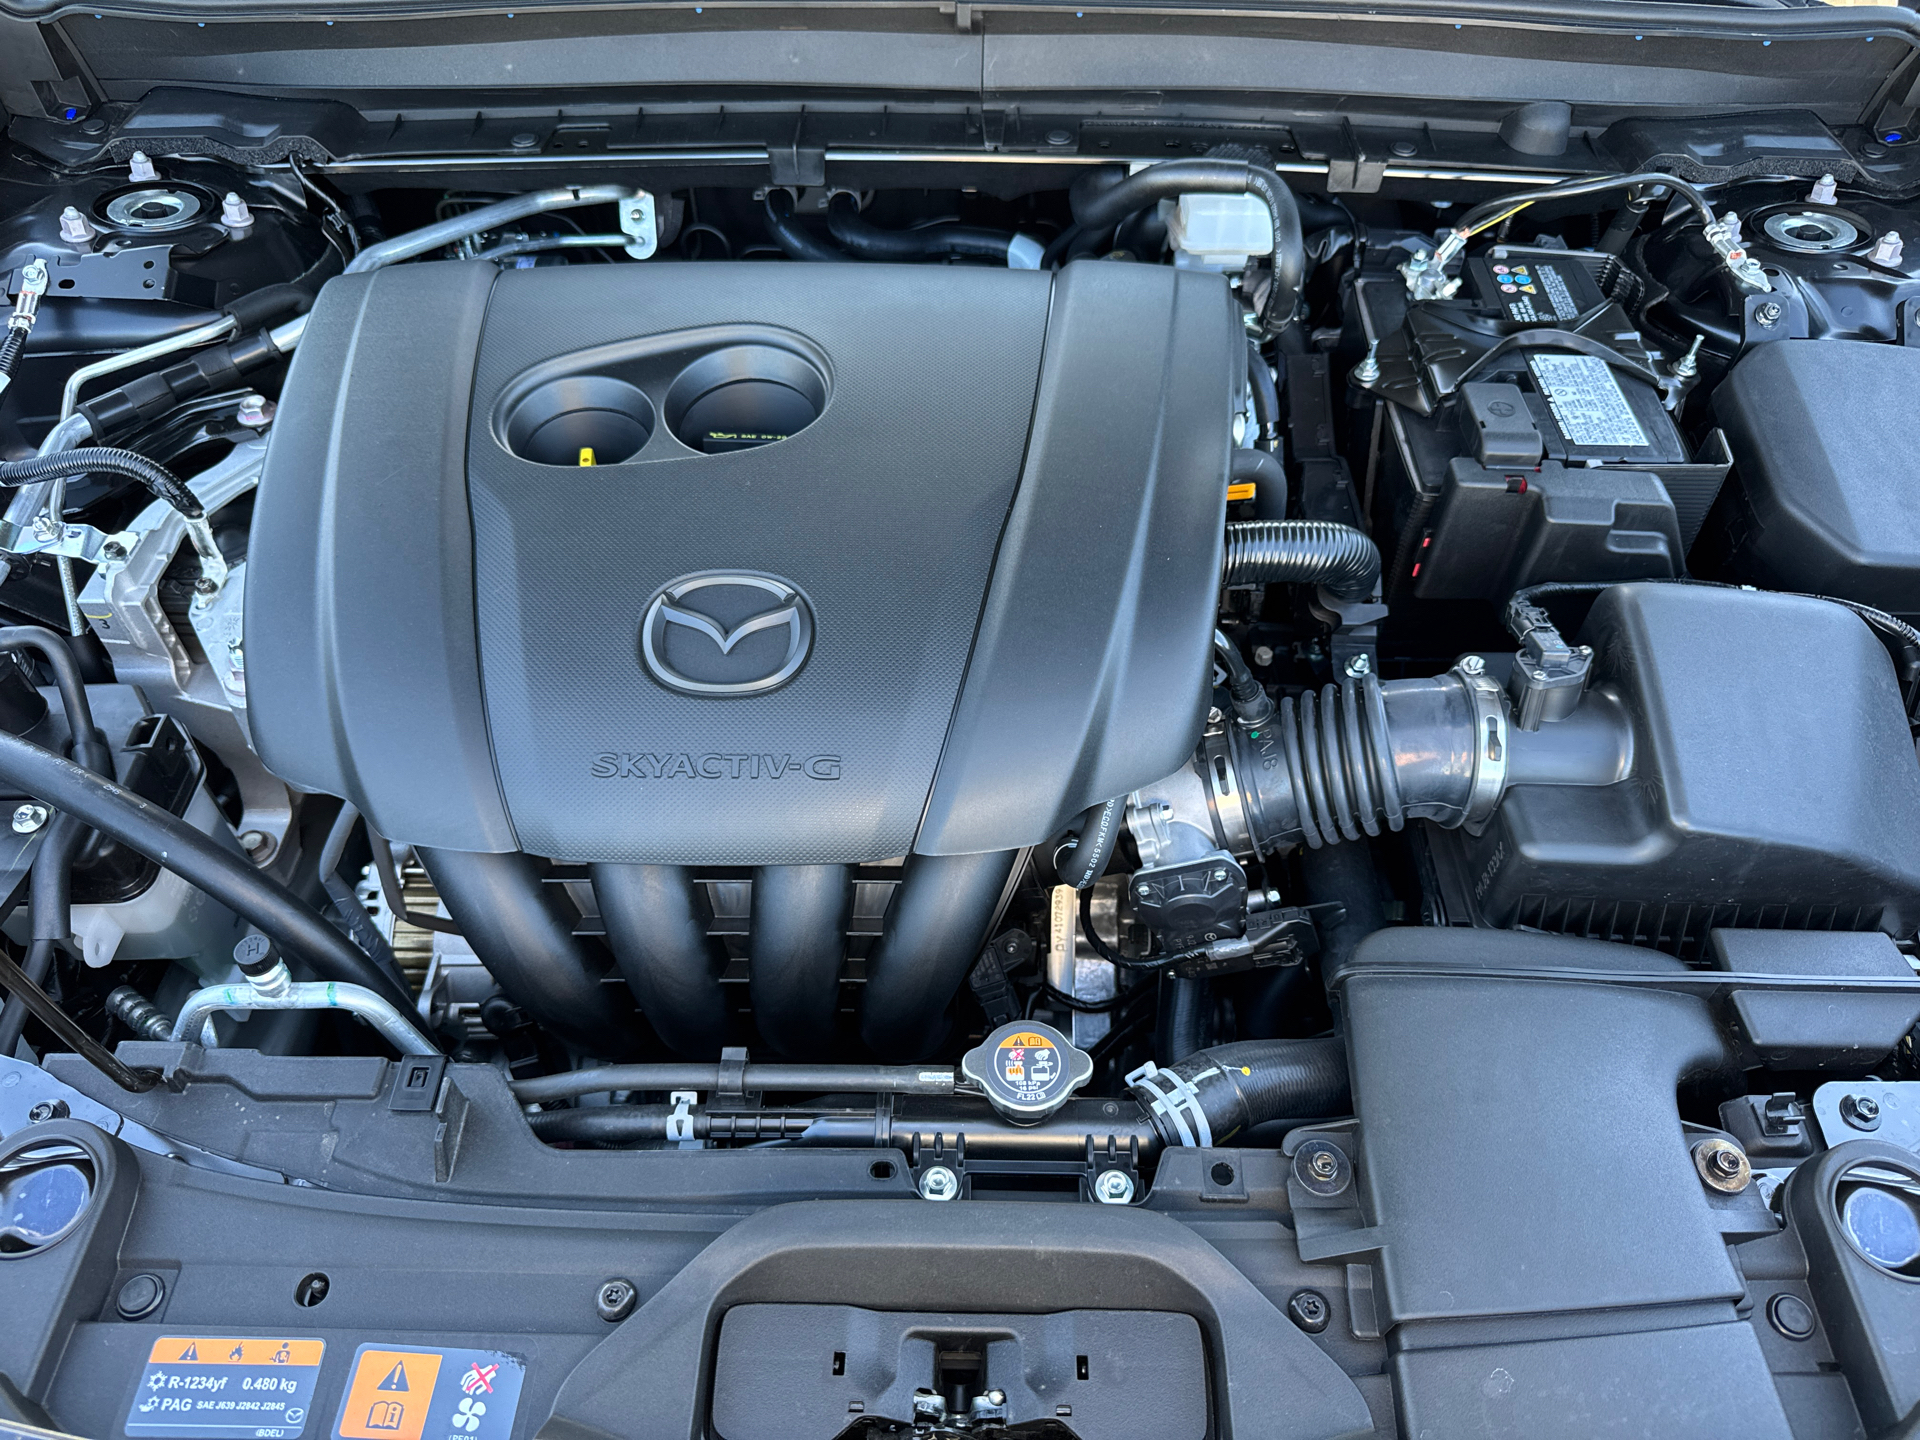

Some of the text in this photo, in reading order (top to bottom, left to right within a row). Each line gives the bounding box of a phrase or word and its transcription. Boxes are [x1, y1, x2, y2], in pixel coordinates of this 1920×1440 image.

[591, 752, 842, 781] SKYACTIV-G
[246, 942, 260, 956] H
[1017, 1092, 1036, 1100] FL22
[167, 1376, 297, 1393] R-1234yf 0.480 kg
[161, 1398, 285, 1411] PAG SAE J639 J2842 J2845
